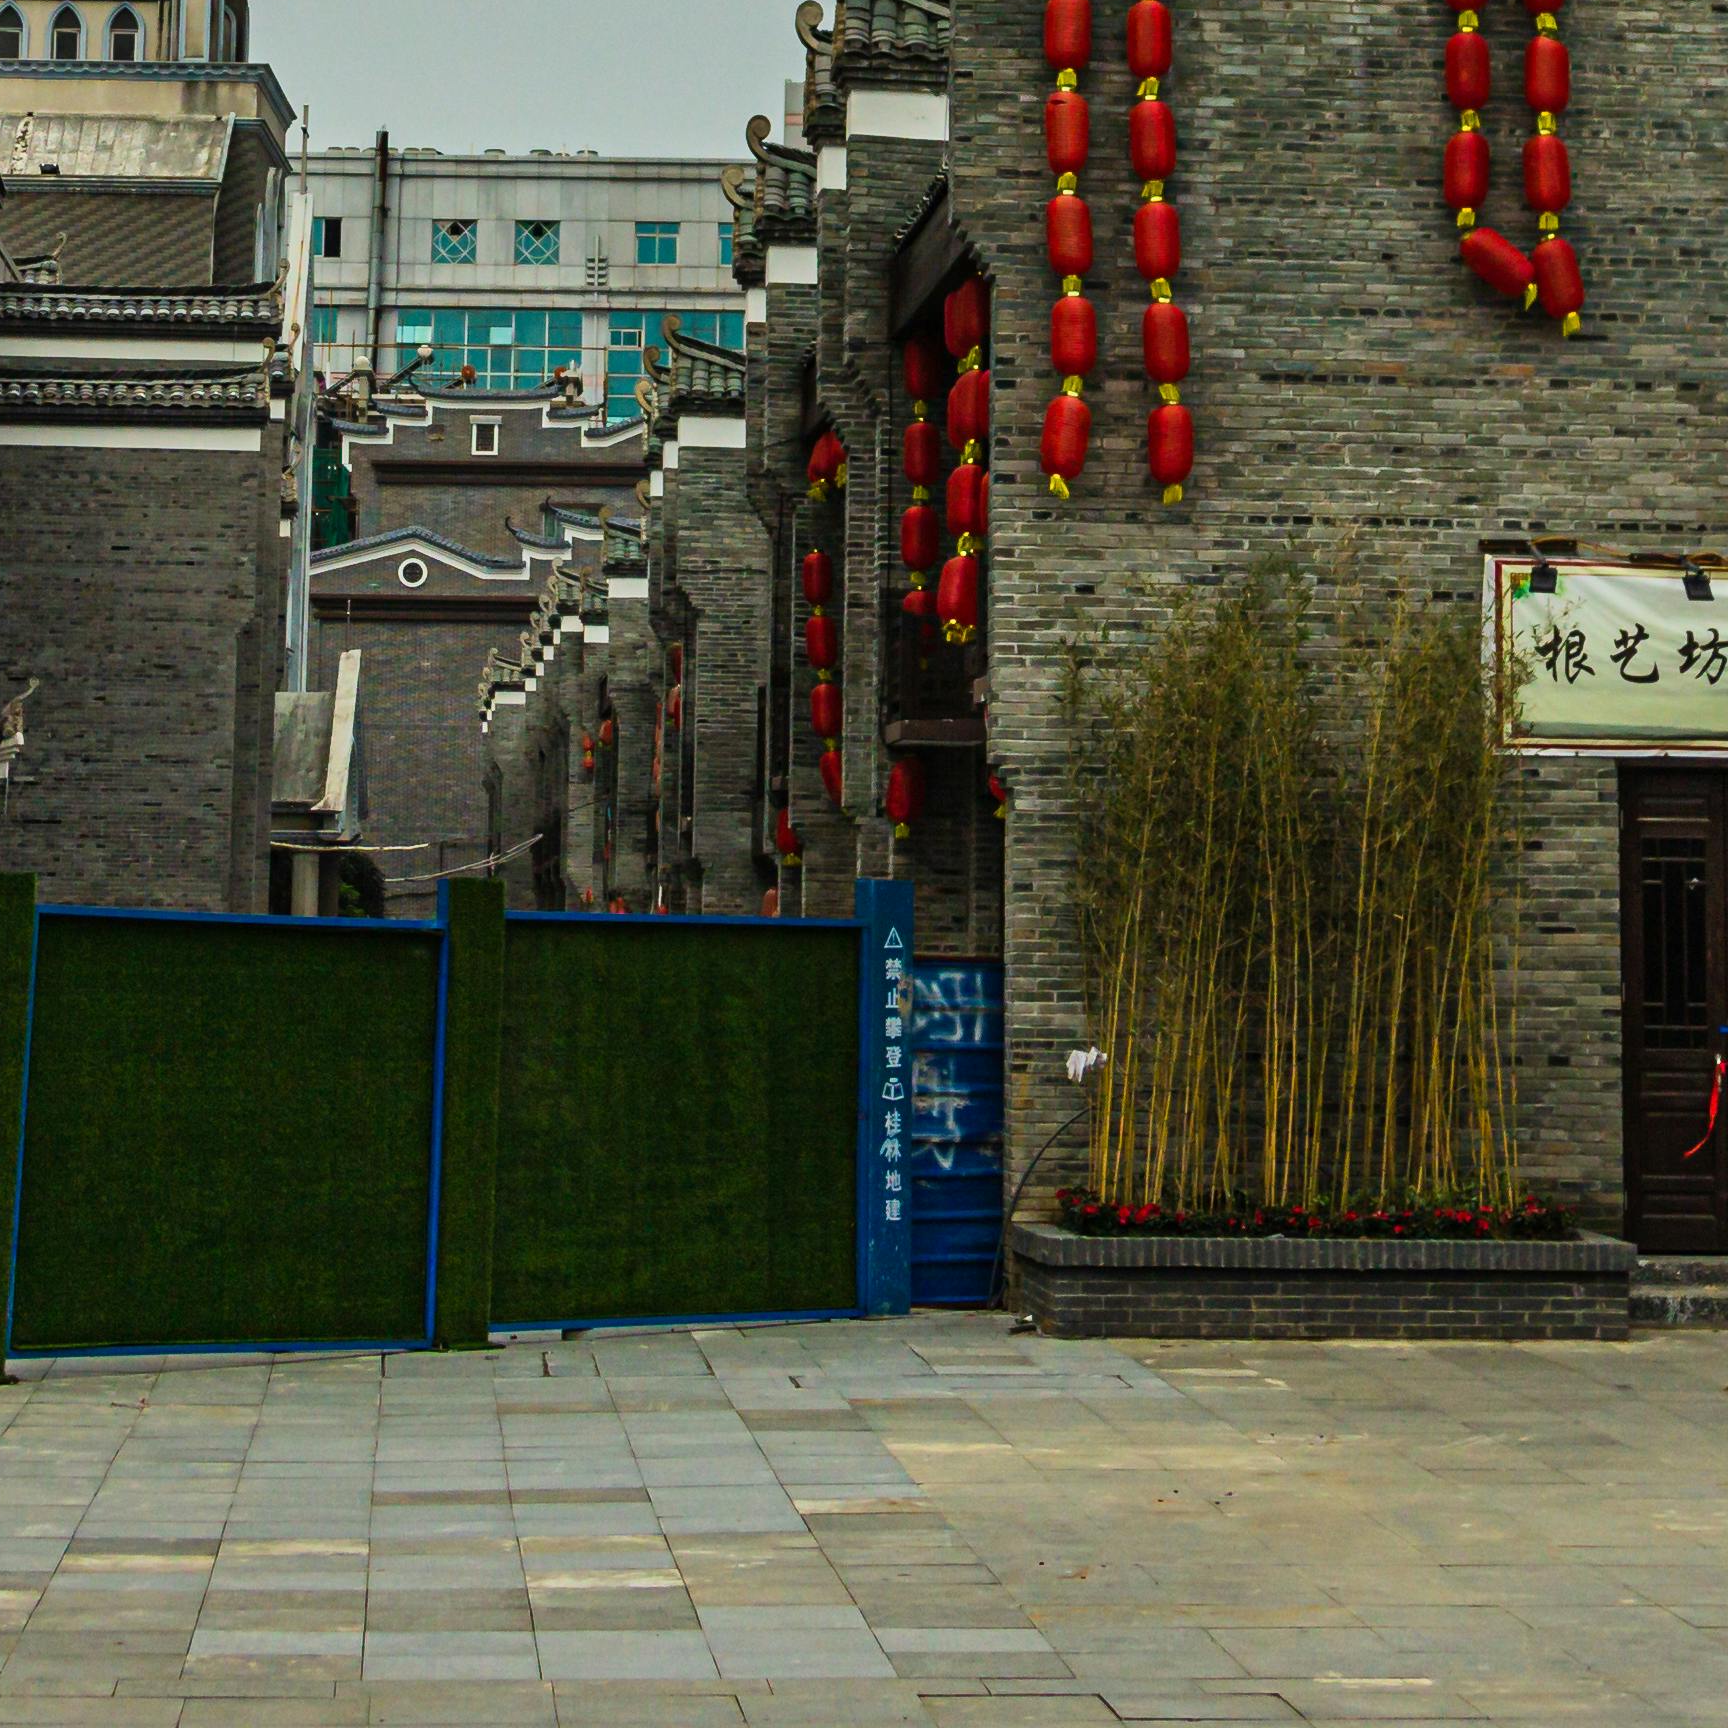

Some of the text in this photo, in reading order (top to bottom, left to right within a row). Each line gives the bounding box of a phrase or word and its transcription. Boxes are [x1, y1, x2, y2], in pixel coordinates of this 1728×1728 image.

[884, 957, 903, 1069] 禁止攀登
[880, 1108, 903, 1222] 桂林地建
